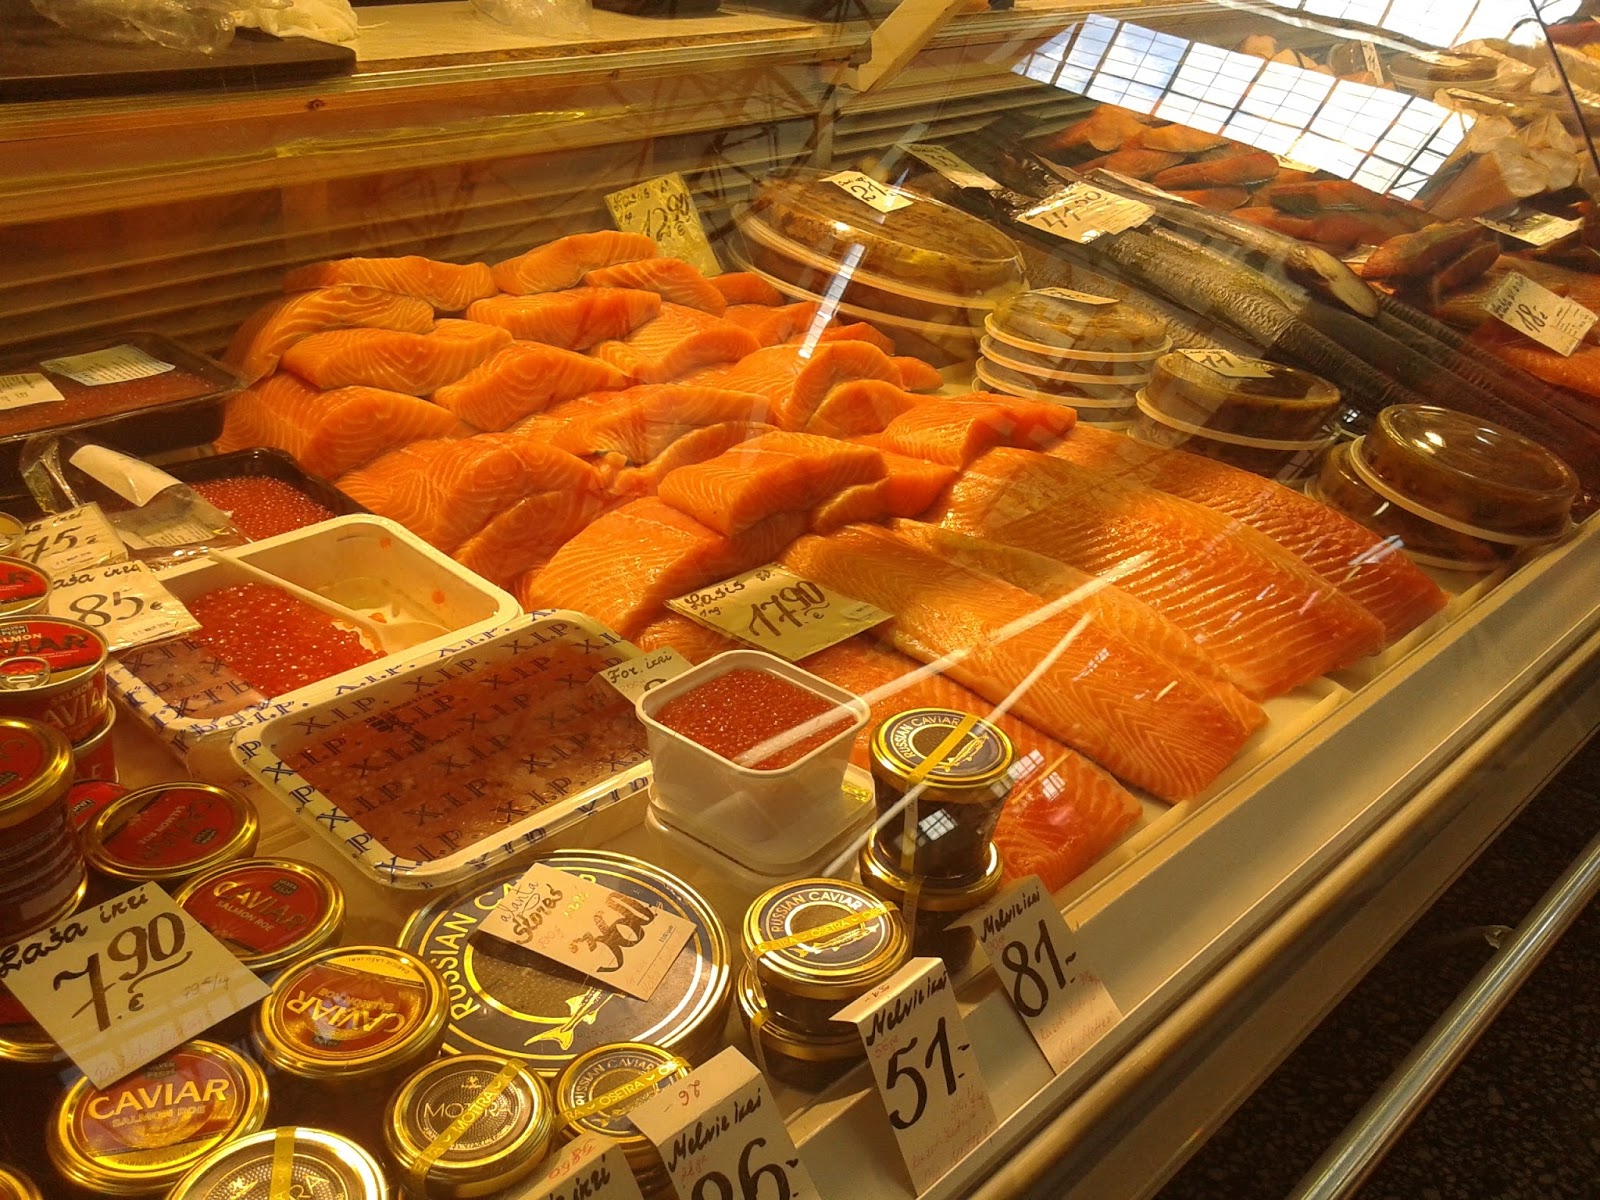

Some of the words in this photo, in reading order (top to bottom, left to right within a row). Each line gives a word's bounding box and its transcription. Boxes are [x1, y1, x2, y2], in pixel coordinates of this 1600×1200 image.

[69, 590, 145, 628] 85
[894, 724, 916, 758] RUSSIAN
[911, 715, 961, 727] CAVIAR
[215, 900, 254, 922] SALMON
[254, 919, 276, 933] ROE
[770, 894, 807, 933] RUSSIAN
[808, 891, 864, 911] CAVIAR
[810, 920, 851, 937] OSETRA
[430, 911, 482, 1021] RUSSIAN
[286, 990, 406, 1034] CAVIAR
[87, 1078, 231, 1121] CAVIAR
[575, 1064, 606, 1106] RUSSIAN
[599, 1080, 645, 1106] OSETRA
[112, 1109, 174, 1129] SALMON
[177, 1104, 206, 1117] ROE
